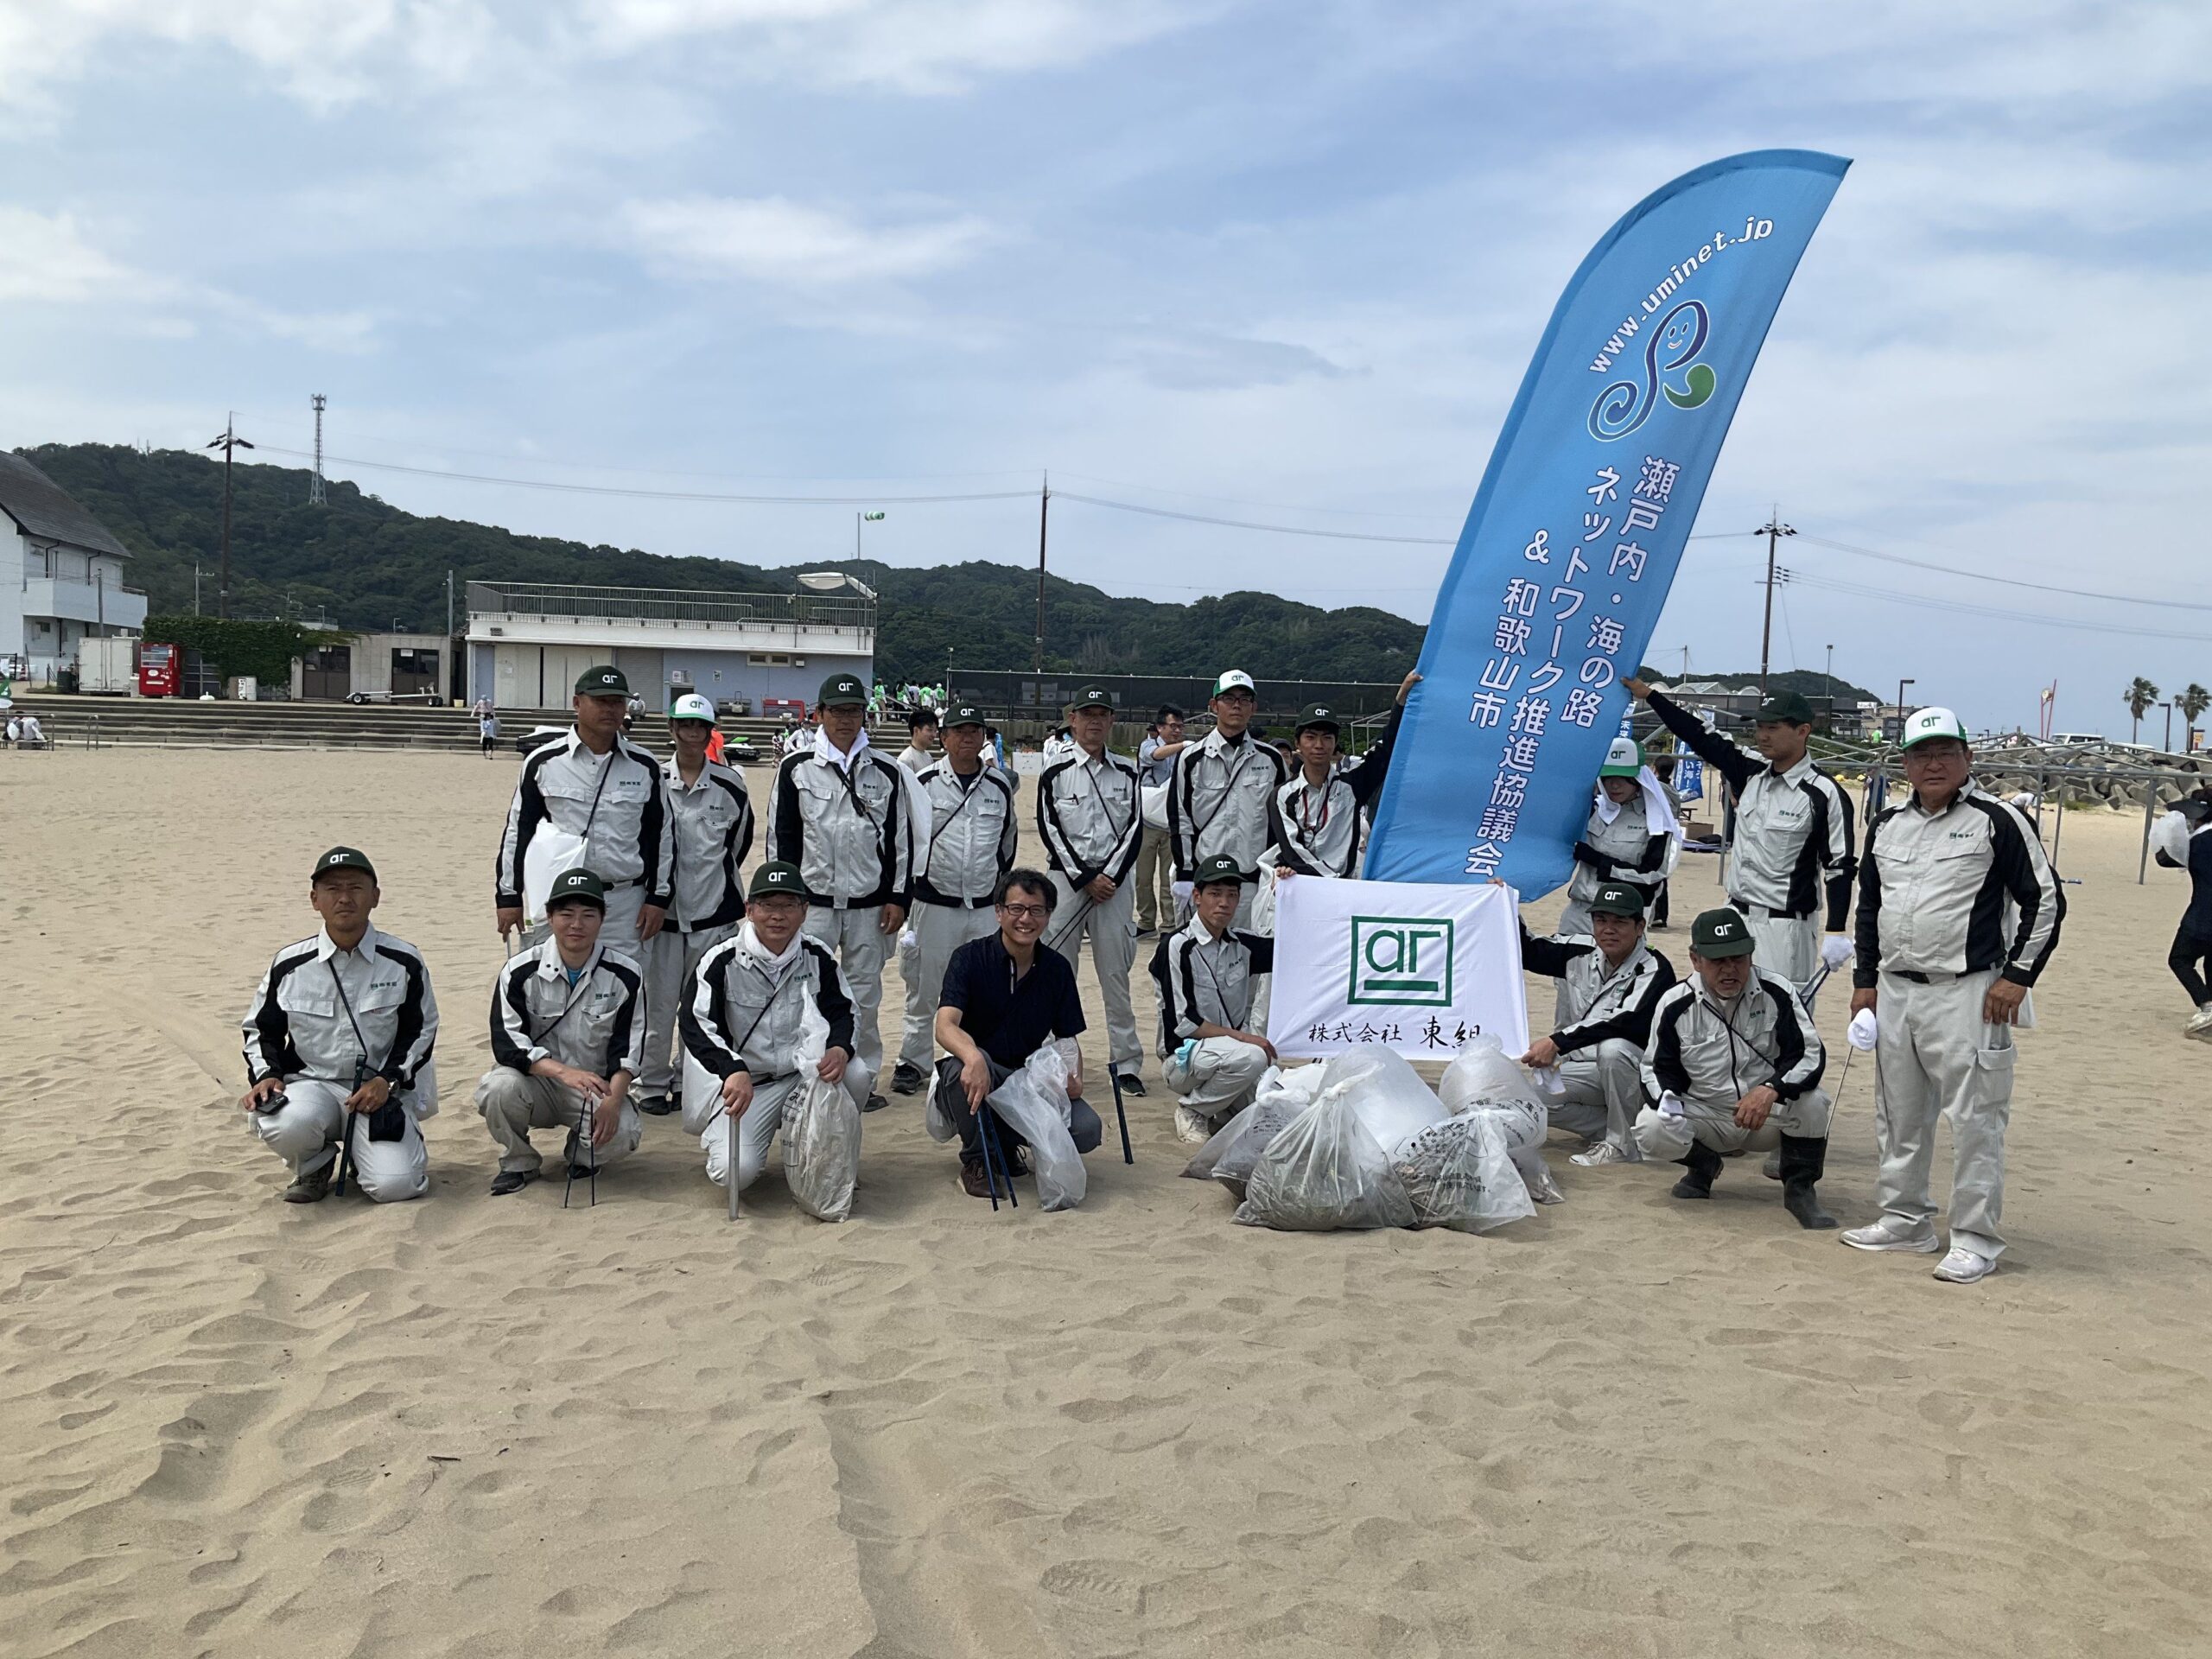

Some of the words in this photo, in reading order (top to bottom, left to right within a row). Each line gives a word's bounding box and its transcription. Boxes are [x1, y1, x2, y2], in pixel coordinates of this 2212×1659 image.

[1588, 215, 1774, 373] www.uminet.jp
[1470, 577, 1541, 728] 和歌山市
[1560, 454, 1681, 728] 瀬戸内・海の路
[1464, 466, 1620, 877] ネットワーク推進協議会
[1364, 929, 1441, 974] ar
[1308, 1022, 1402, 1044] 株式会社
